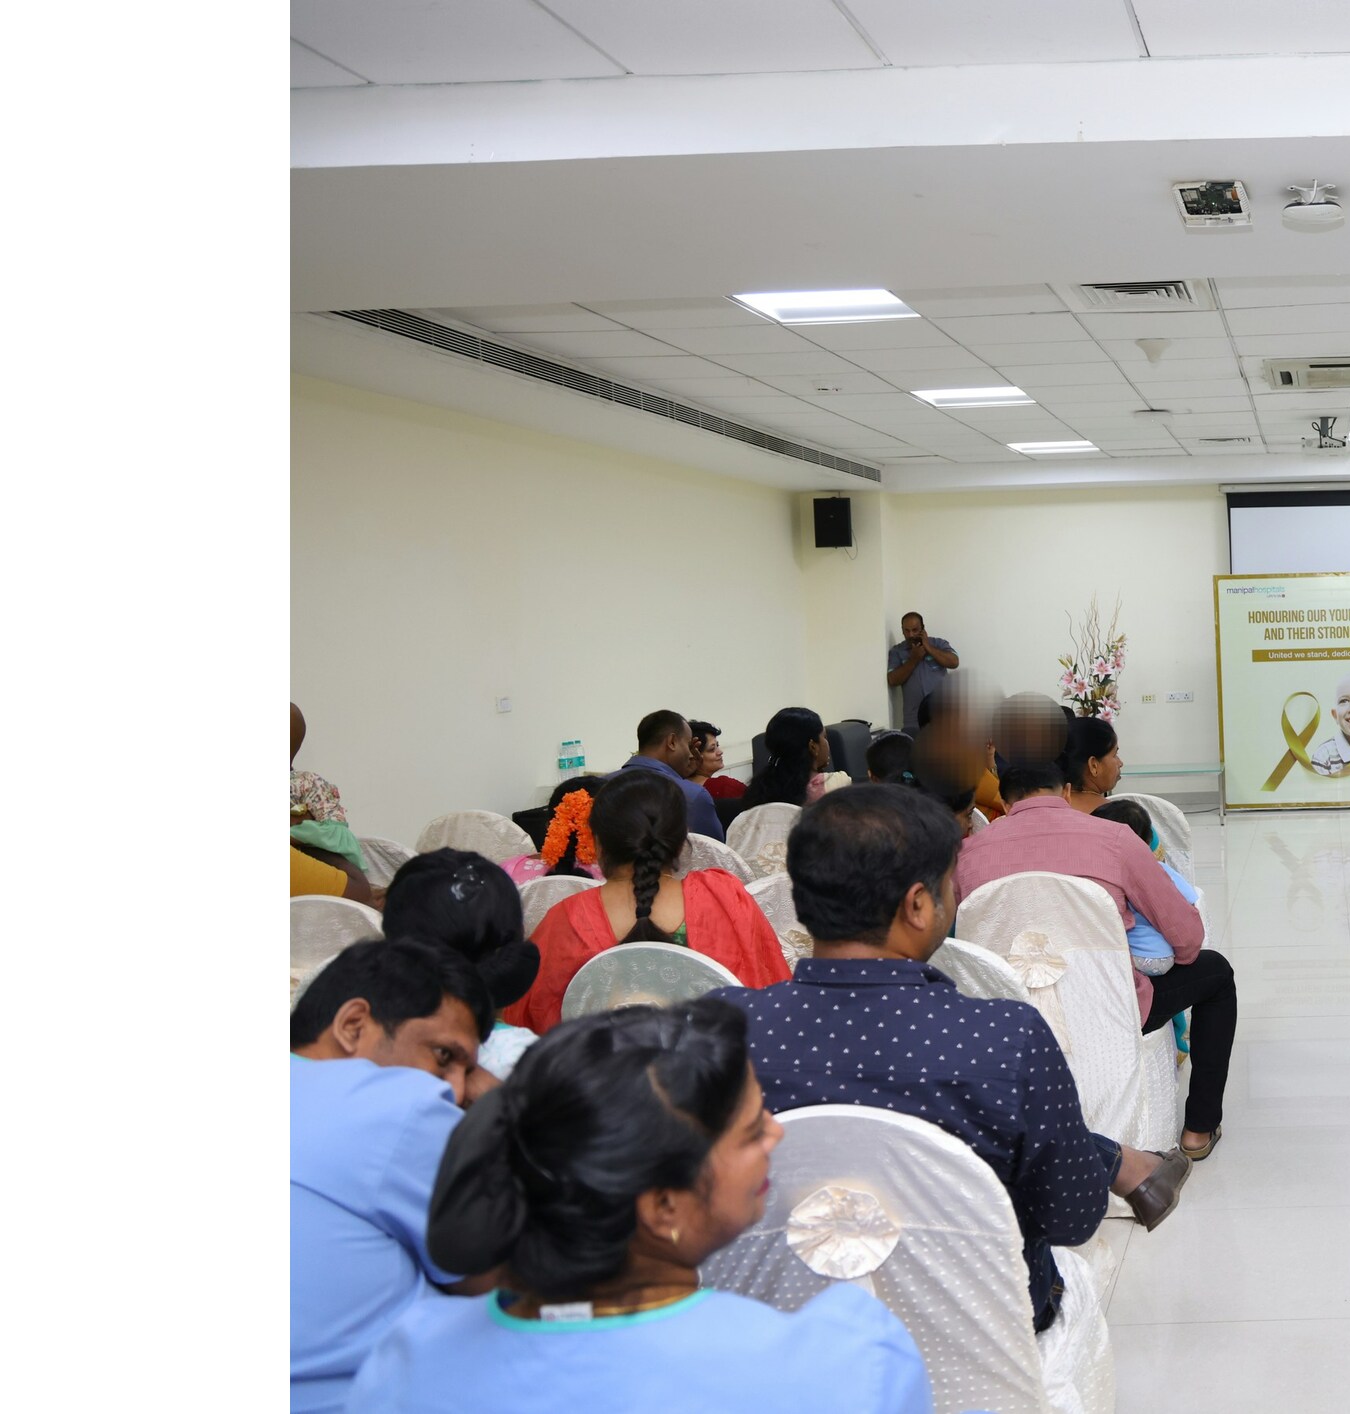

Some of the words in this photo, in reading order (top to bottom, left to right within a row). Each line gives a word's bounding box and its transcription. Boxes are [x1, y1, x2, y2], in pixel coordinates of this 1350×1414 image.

[1248, 610, 1305, 624] HONOURING
[1307, 608, 1327, 622] OUR
[1264, 627, 1285, 640] AND
[1287, 626, 1316, 640] THEIR
[1268, 651, 1293, 659] United
[1307, 651, 1330, 659] stand,
